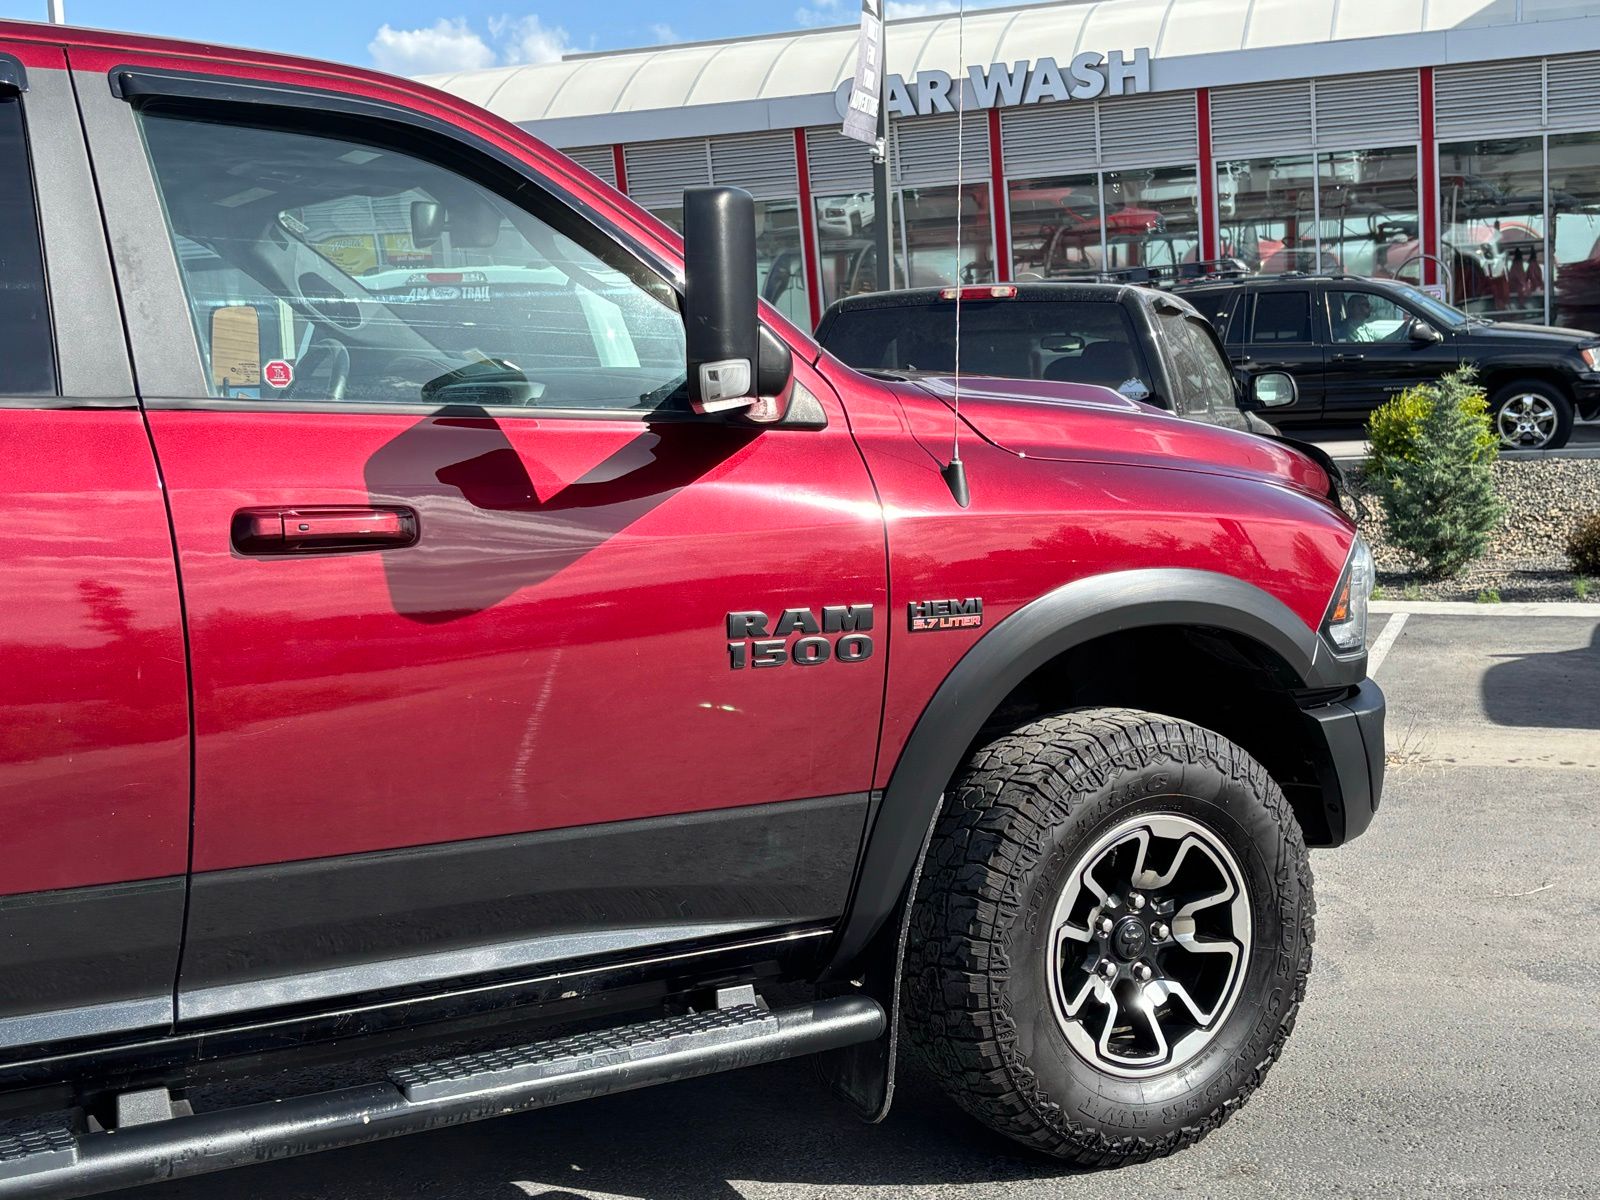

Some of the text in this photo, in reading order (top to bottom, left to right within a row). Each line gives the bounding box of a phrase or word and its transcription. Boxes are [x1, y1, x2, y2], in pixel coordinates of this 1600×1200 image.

[967, 47, 1150, 108] WASH
[726, 604, 874, 639] RAM
[908, 597, 982, 618] HEMI
[913, 616, 981, 630] 5.7 LITER
[727, 634, 875, 669] 1500
